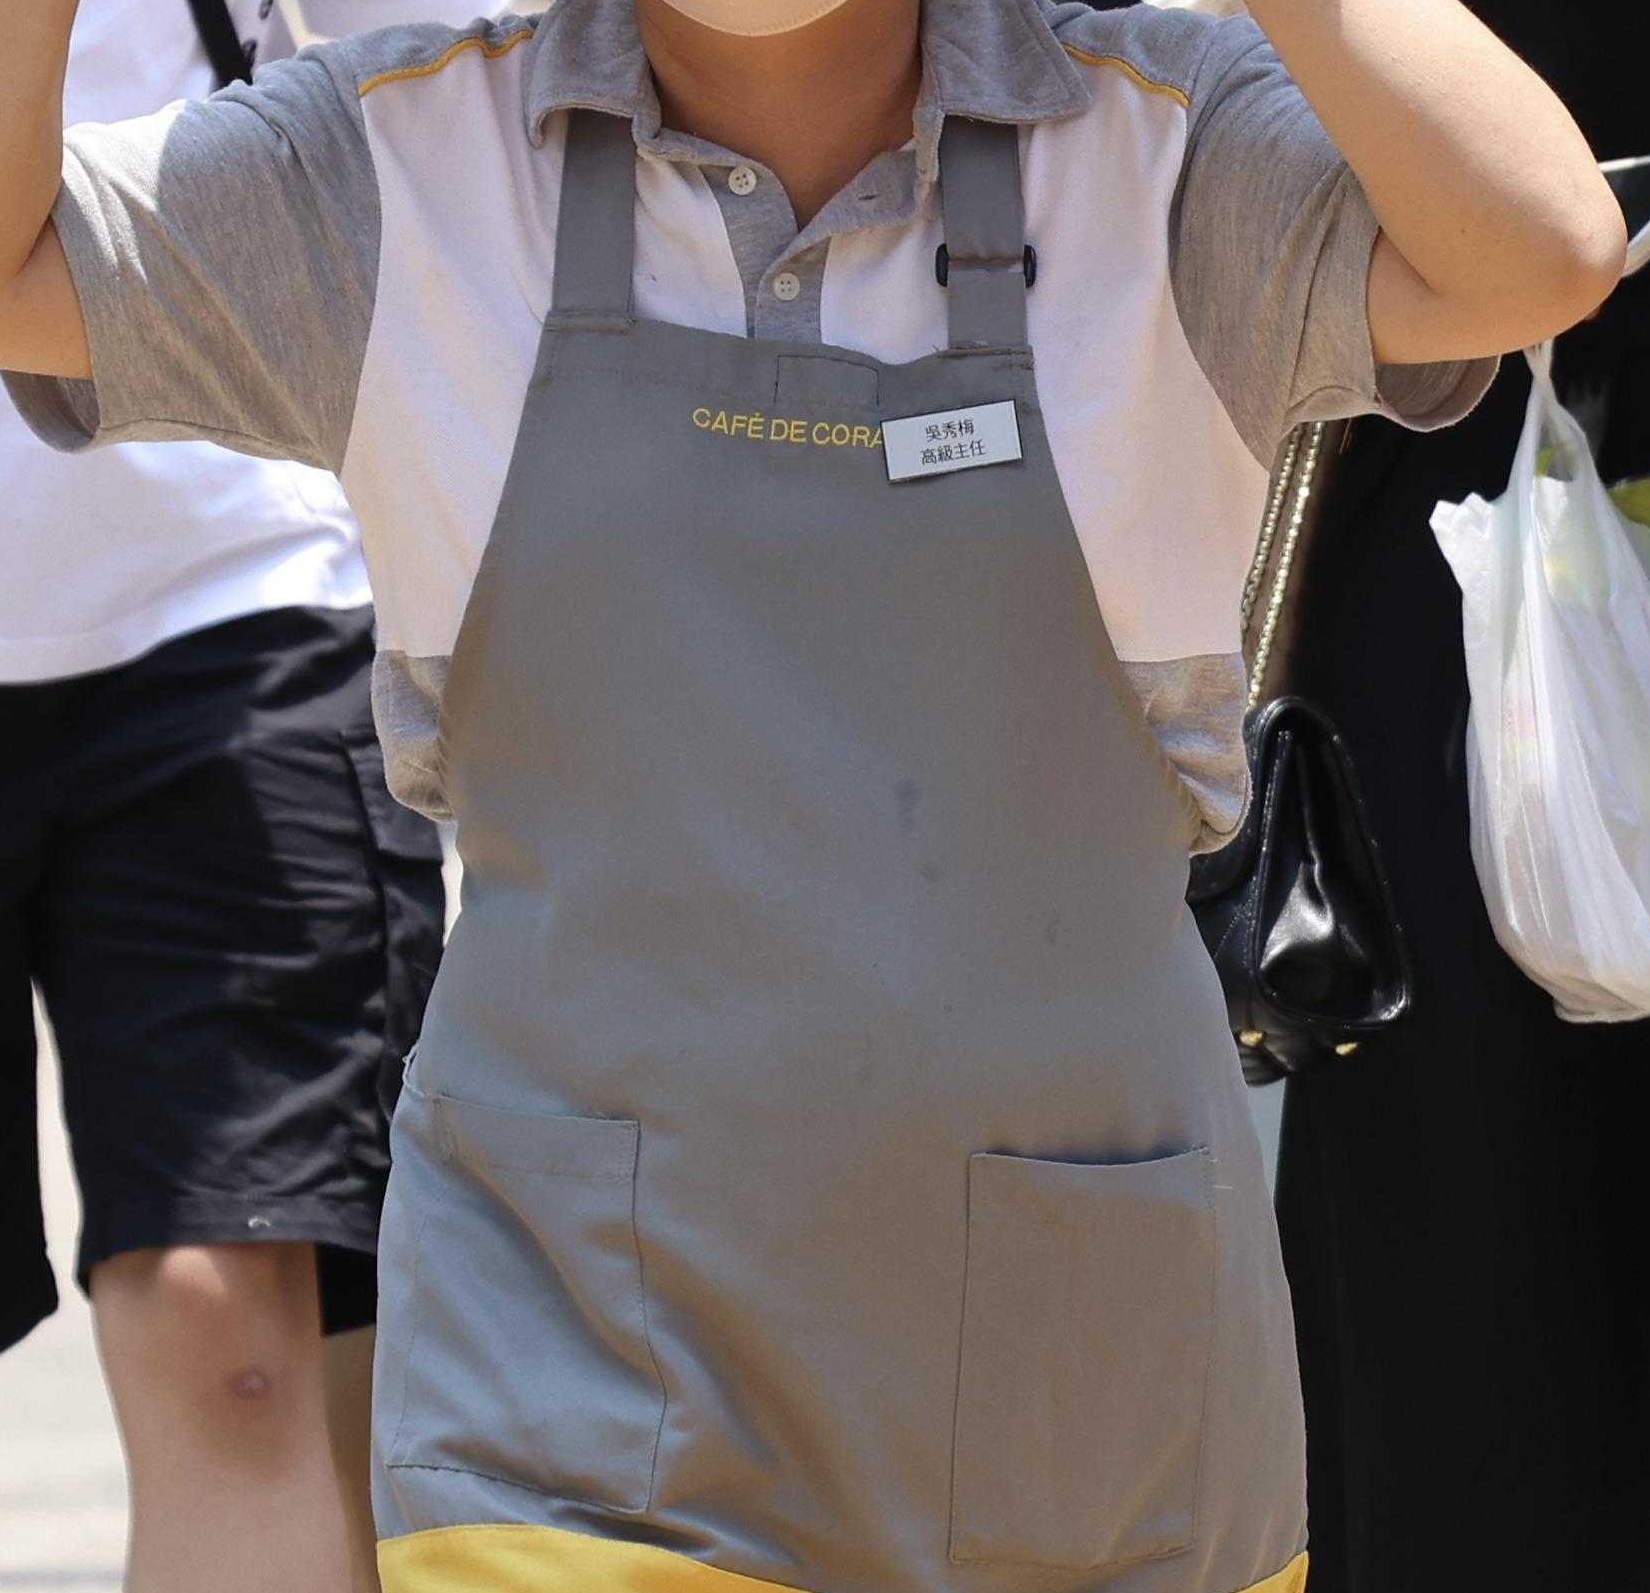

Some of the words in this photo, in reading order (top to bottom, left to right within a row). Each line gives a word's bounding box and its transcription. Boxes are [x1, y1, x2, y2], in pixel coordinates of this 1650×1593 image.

[692, 407, 765, 440] CAFÉ
[770, 418, 808, 443] DE
[920, 439, 987, 466] 高級主任
